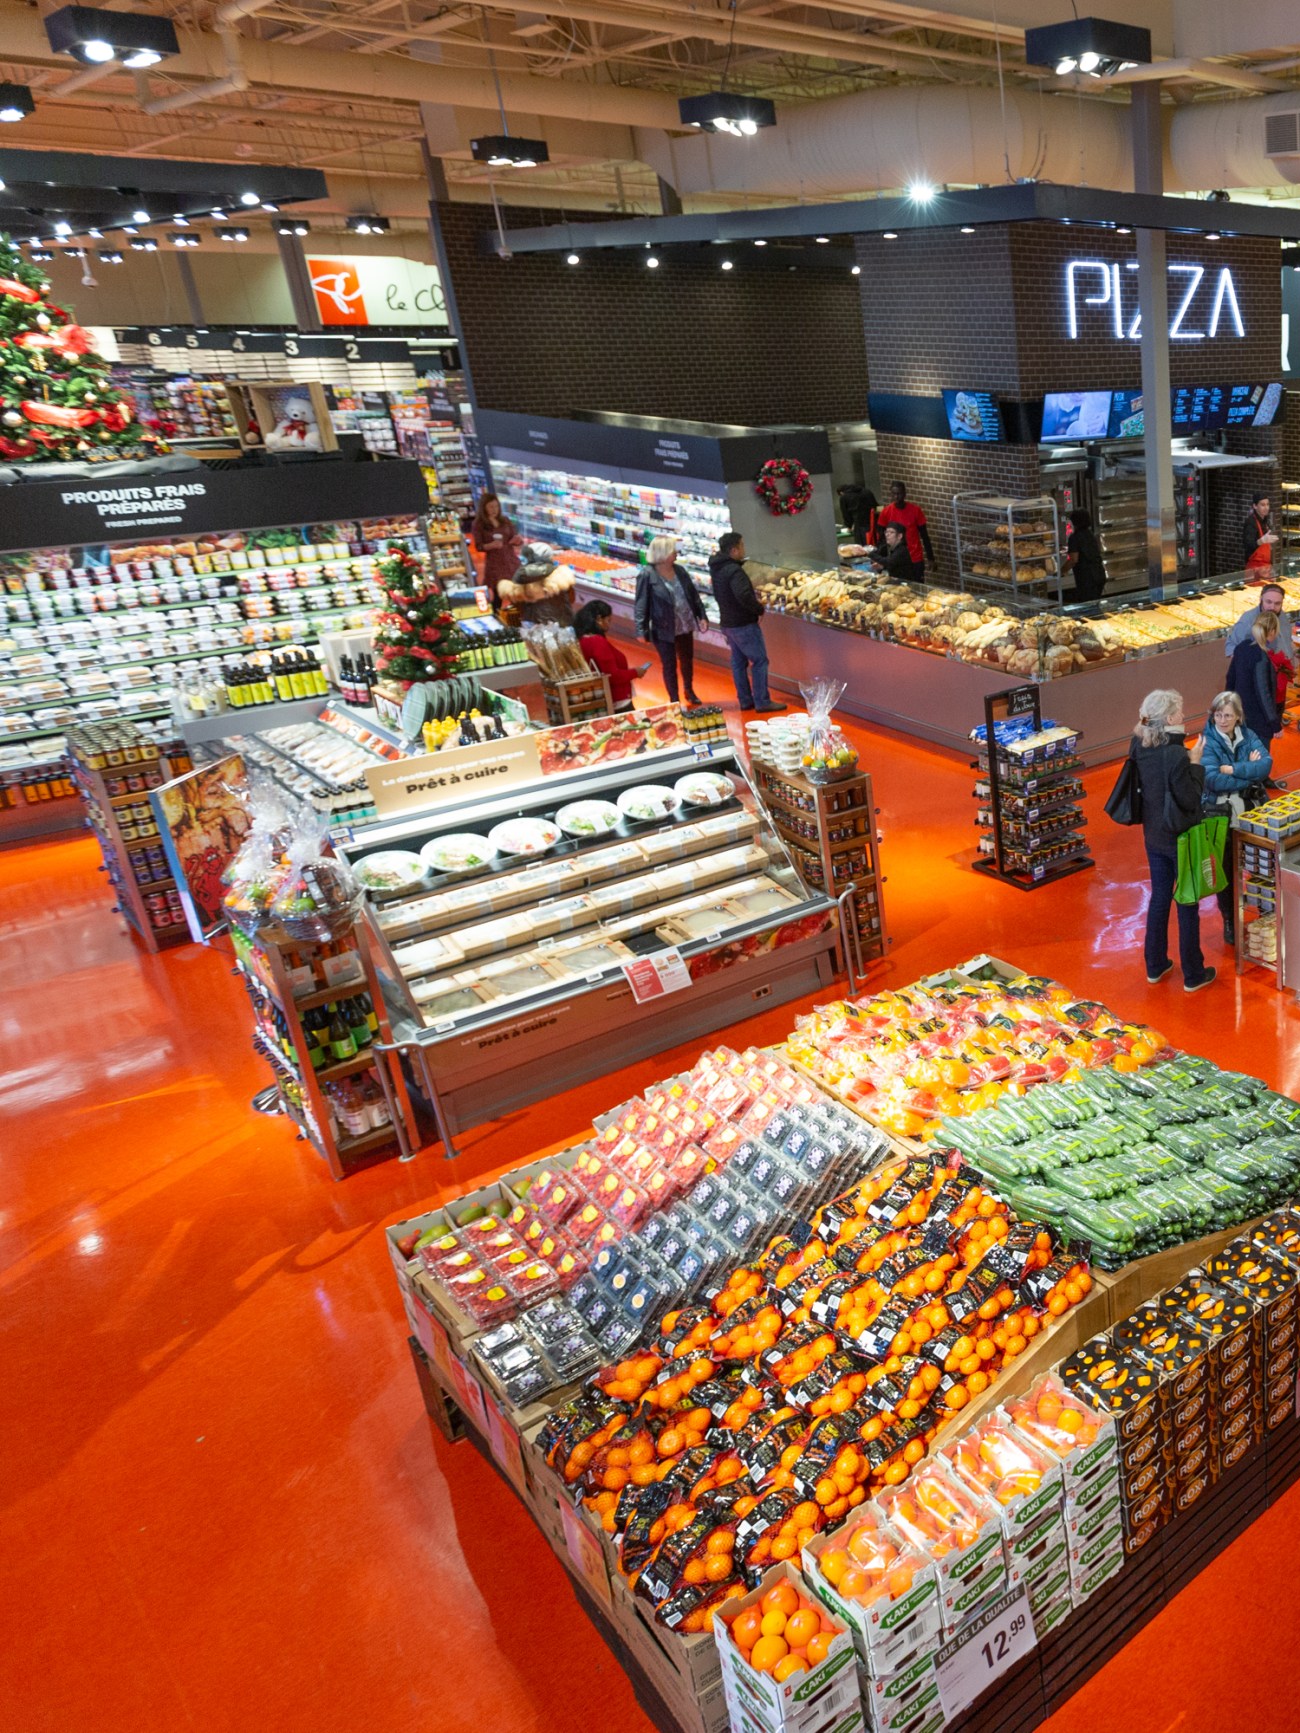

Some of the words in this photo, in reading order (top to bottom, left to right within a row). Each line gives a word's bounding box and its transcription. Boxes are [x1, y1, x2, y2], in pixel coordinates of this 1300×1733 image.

[149, 332, 162, 346] 6
[186, 334, 199, 348] 5
[232, 337, 246, 351] 4
[285, 340, 299, 356] 3
[346, 343, 361, 360] 2
[60, 486, 153, 505] PRODUITS
[154, 483, 206, 499] FRAIS
[96, 498, 187, 516] PRÉPARÉS
[104, 518, 136, 529] FRESH
[136, 515, 183, 527] PREPARED
[405, 778, 447, 794] Prêt
[449, 773, 461, 785] à
[463, 764, 509, 781] cuire
[478, 1033, 510, 1049] Prêt
[511, 1028, 521, 1039] à
[522, 1017, 558, 1034] cuire
[1270, 1296, 1295, 1322] ROXY
[1223, 1331, 1251, 1360] ROXY
[1271, 1322, 1295, 1350] ROXY
[1224, 1357, 1251, 1387] ROXY
[1271, 1349, 1295, 1375] ROXY
[1176, 1366, 1205, 1395] ROXY
[1270, 1374, 1295, 1402] ROXY
[1177, 1394, 1206, 1424] ROXY
[1224, 1383, 1251, 1413] ROXY
[1126, 1402, 1156, 1434] ROXY
[1224, 1411, 1251, 1440] ROXY
[1269, 1399, 1294, 1426] ROXY
[1128, 1433, 1158, 1466] ROXY
[1178, 1422, 1206, 1453] ROXY
[1225, 1436, 1252, 1464] ROXY
[1076, 1452, 1096, 1473] KAKI
[1179, 1447, 1207, 1478] ROXY
[1129, 1463, 1160, 1495] ROXY
[1180, 1475, 1208, 1507] ROXY
[1079, 1483, 1098, 1504] KAKI
[1134, 1490, 1164, 1523] ROXY
[1019, 1499, 1040, 1521] KAKI
[1081, 1513, 1100, 1534] KAKI
[1129, 1516, 1158, 1550] ROXY
[1019, 1529, 1040, 1551] KAKI
[1083, 1543, 1102, 1563] KAKI
[955, 1551, 977, 1576] KAKI
[1085, 1571, 1104, 1591] KAKI
[959, 1585, 980, 1609] KAKI
[886, 1600, 910, 1625] KAKI
[938, 1645, 957, 1662] QUE
[958, 1632, 971, 1643] DE
[971, 1621, 983, 1633] LA
[985, 1586, 1021, 1622] QUALITÉ
[1036, 1617, 1049, 1635] AKI
[800, 1670, 826, 1698] KAKI
[890, 1669, 914, 1693] KAKI
[895, 1701, 919, 1726] KAKI
